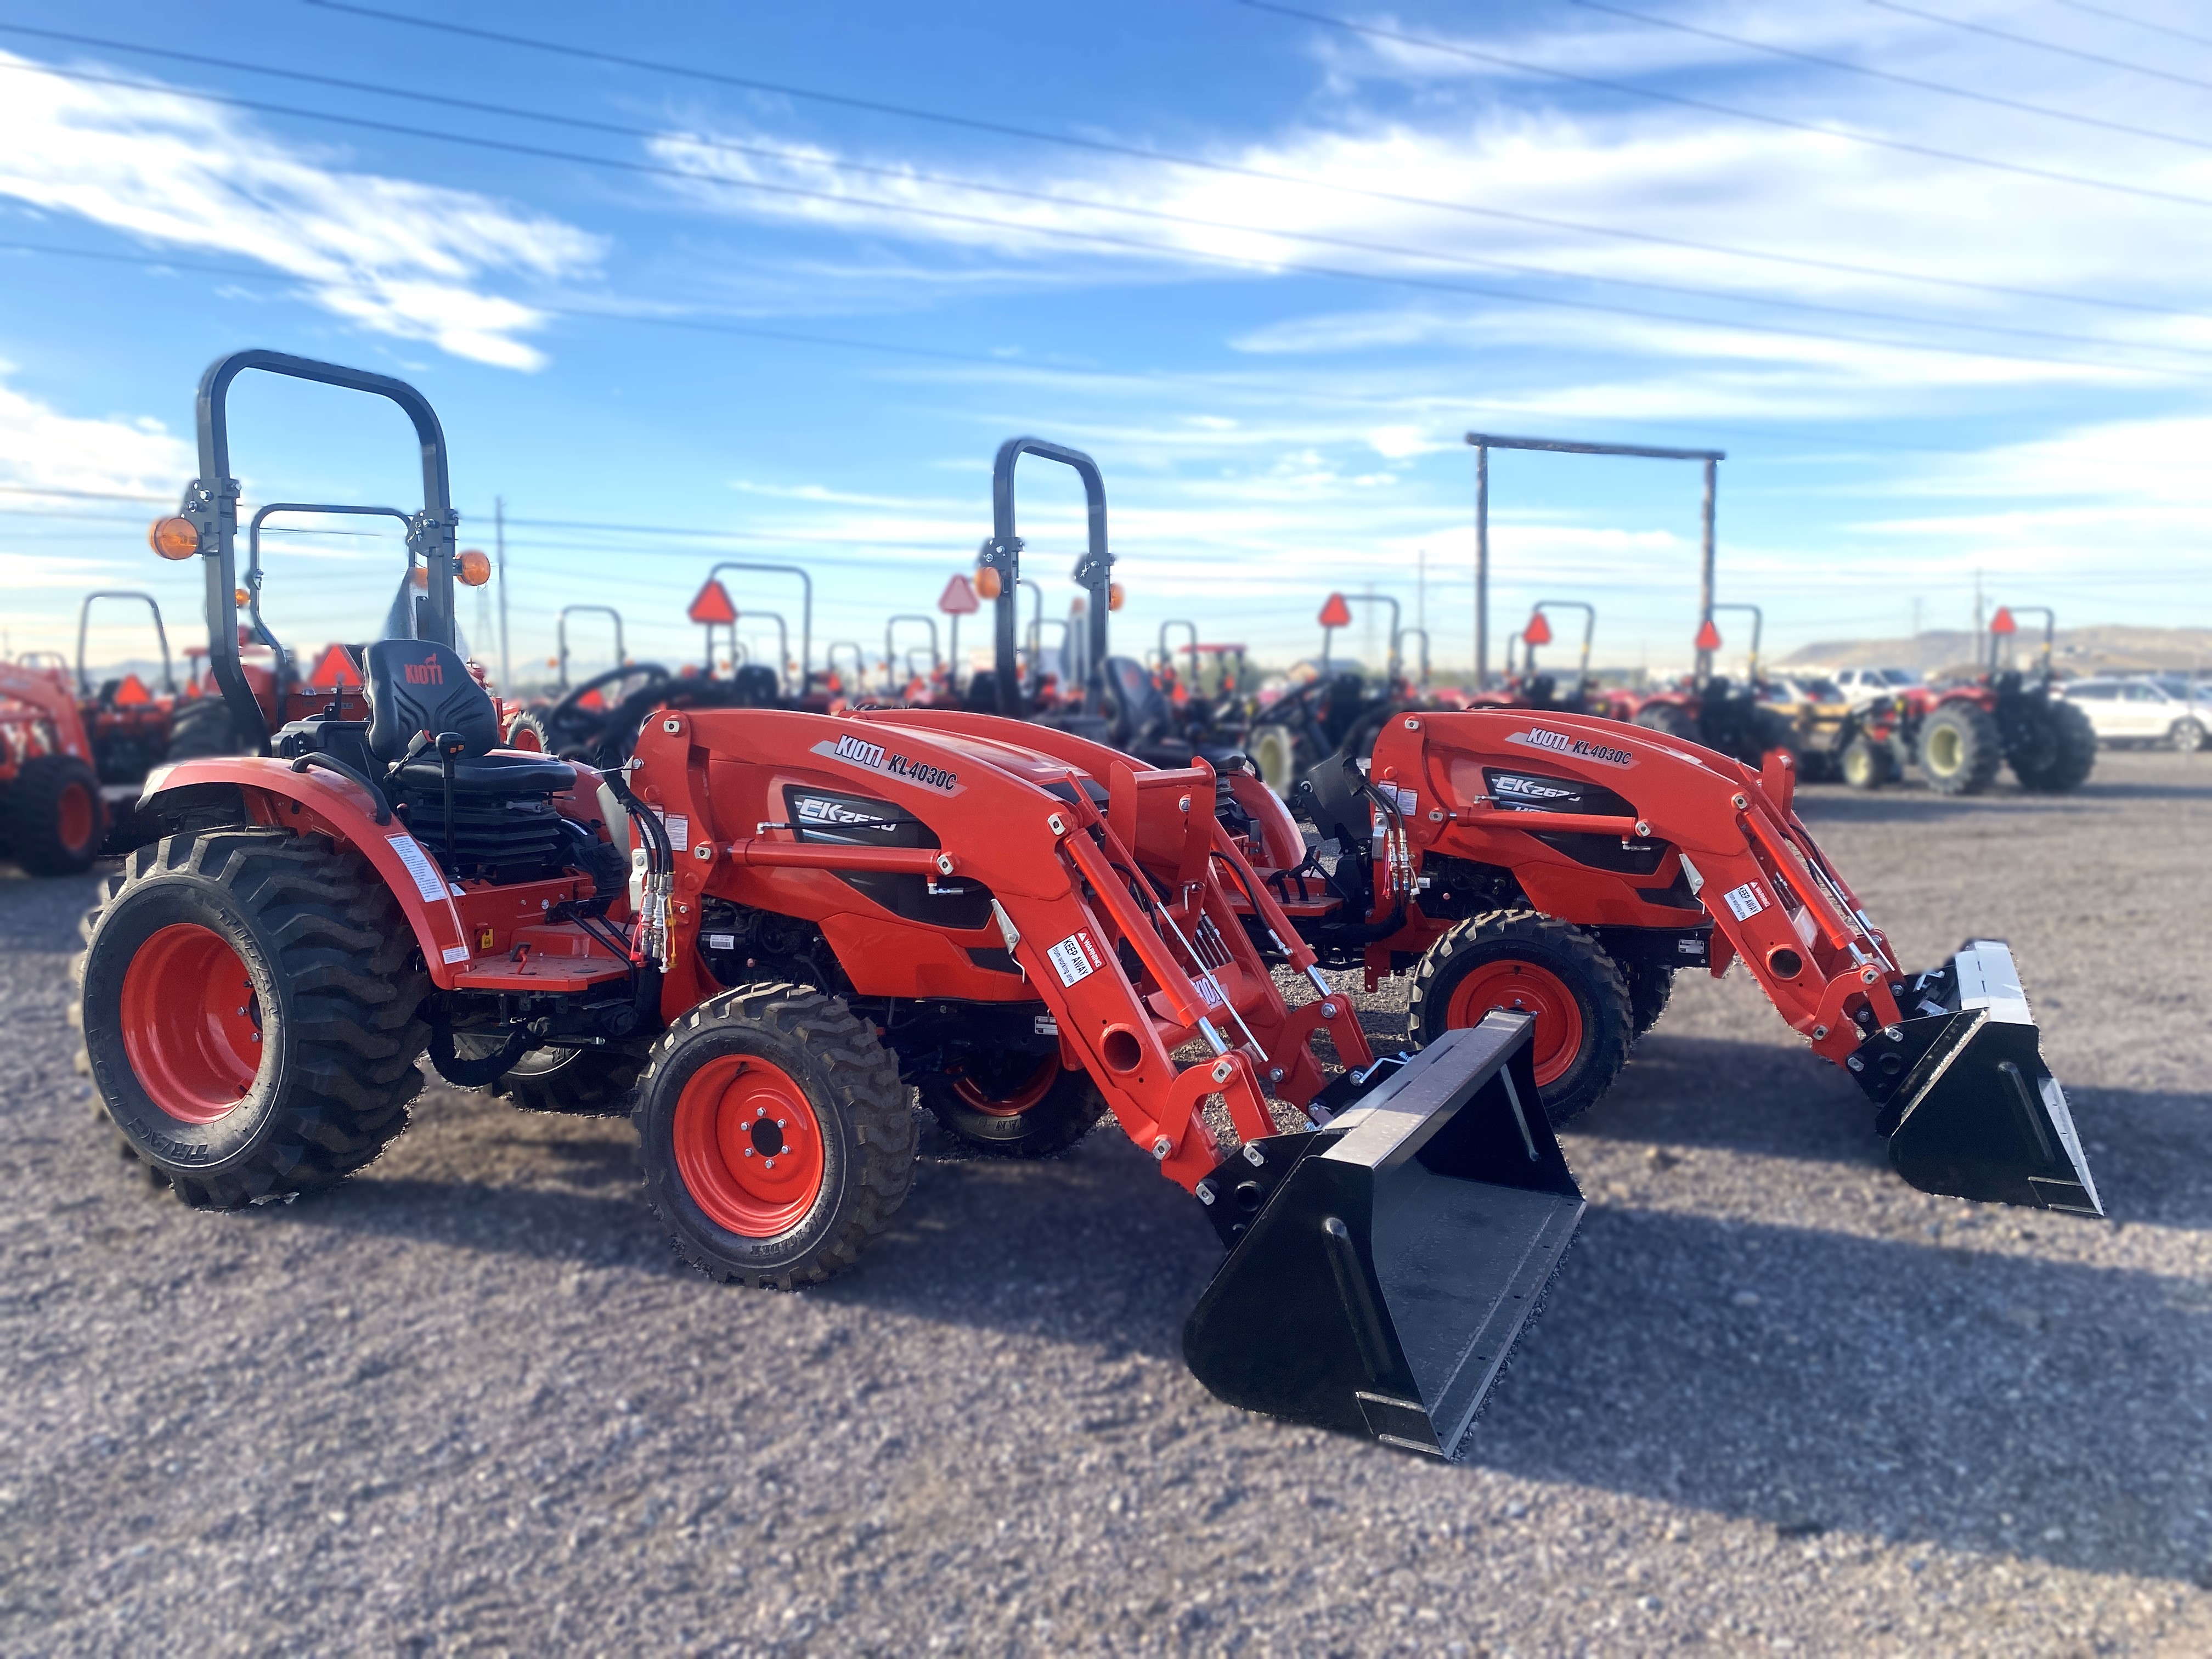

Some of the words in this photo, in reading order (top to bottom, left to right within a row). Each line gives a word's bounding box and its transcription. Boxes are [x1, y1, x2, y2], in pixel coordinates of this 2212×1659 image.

[404, 664, 443, 685] KIOTI
[1526, 727, 1570, 751] KIOTI
[1572, 740, 1632, 765] KL4030C
[834, 733, 886, 768] KIOTI
[887, 753, 957, 791] KL4030C
[1737, 886, 1750, 899] KEEP
[1745, 899, 1759, 913] AWAY
[1755, 886, 1770, 907] WARNING
[218, 907, 280, 1023] TITAN
[1063, 939, 1078, 956] KEEP
[1071, 957, 1088, 976] AWAY
[1084, 939, 1102, 968] WARNING
[1058, 956, 1069, 974] working
[1066, 973, 1075, 983] area
[1188, 974, 1221, 1005] KIO
[127, 1118, 209, 1161] TRAC
[750, 1229, 804, 1256] LOADER
